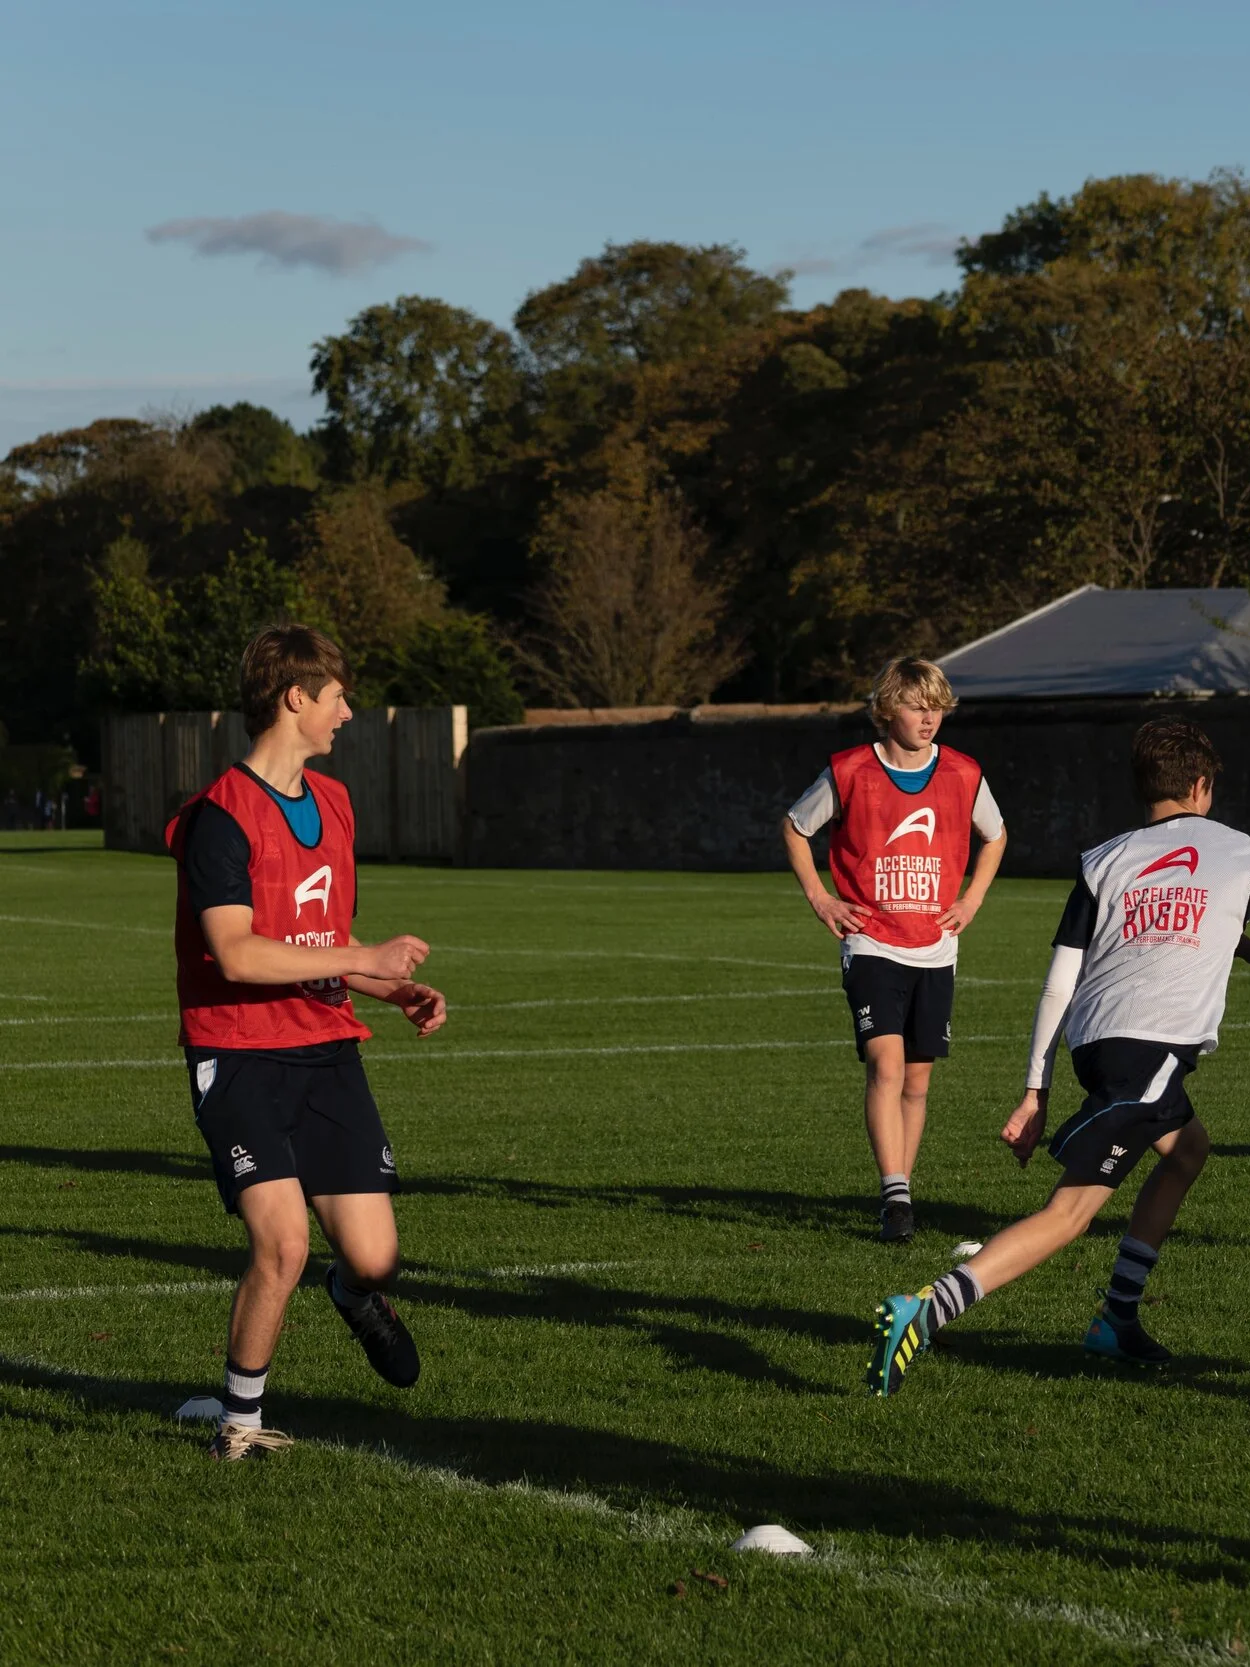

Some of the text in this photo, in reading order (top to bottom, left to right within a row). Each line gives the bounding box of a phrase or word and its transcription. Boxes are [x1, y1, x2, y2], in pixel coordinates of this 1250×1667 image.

[875, 855, 941, 873] ACCELERATE
[875, 872, 941, 901] RUGBY
[1124, 887, 1208, 910] ACCELERATE
[1123, 902, 1206, 939] RUGBY
[285, 930, 336, 947] ACCATE
[231, 1145, 247, 1158] CL
[1111, 1145, 1128, 1157] TW
